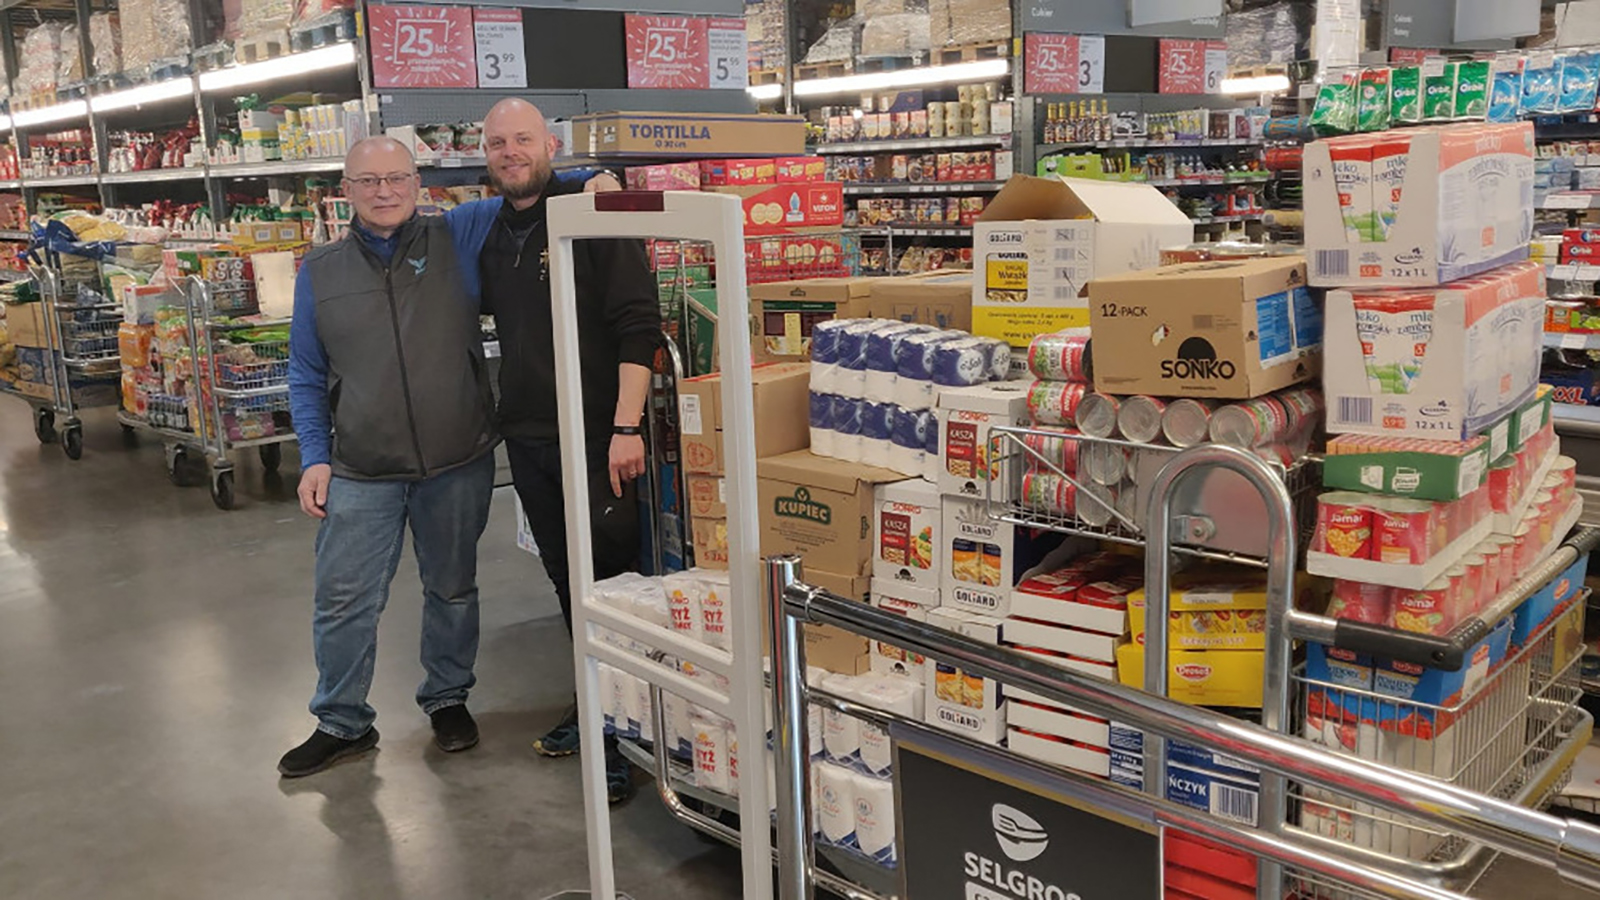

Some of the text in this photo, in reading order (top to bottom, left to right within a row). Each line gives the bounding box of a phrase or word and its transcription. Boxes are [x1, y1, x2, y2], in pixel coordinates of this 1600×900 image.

[400, 25, 434, 57] 25
[649, 33, 676, 62] 25
[484, 54, 516, 80] 3 99
[1039, 50, 1058, 72] 25
[1171, 53, 1187, 74] 25
[716, 58, 729, 81] 5
[1080, 60, 1091, 87] 3
[1207, 71, 1215, 89] 6
[1394, 89, 1416, 99] Orbit
[1427, 86, 1451, 96] Orbit
[1459, 83, 1484, 93] Orbit
[629, 124, 711, 140] TORTILLA
[1333, 162, 1357, 174] leko
[1391, 268, 1403, 278] 12
[1404, 270, 1411, 278] x
[1421, 268, 1428, 277] L
[1100, 303, 1148, 317] 12-PACK
[1356, 312, 1432, 323] leko mle
[1161, 358, 1236, 380] SONKO
[1416, 421, 1427, 430] 12
[1447, 421, 1454, 430] L
[950, 430, 975, 440] KASZA
[778, 501, 828, 520] KUPIEC
[892, 502, 922, 514] SONKO
[1330, 512, 1363, 523] Jamar
[1383, 519, 1410, 529] Jamar
[956, 590, 995, 607] GOLIARD
[1402, 598, 1435, 608] Jamar
[670, 607, 690, 620] RYŻ
[703, 609, 723, 623] RYŻ
[940, 709, 979, 729] GOLIARD
[1169, 774, 1207, 797] ŃCZYK
